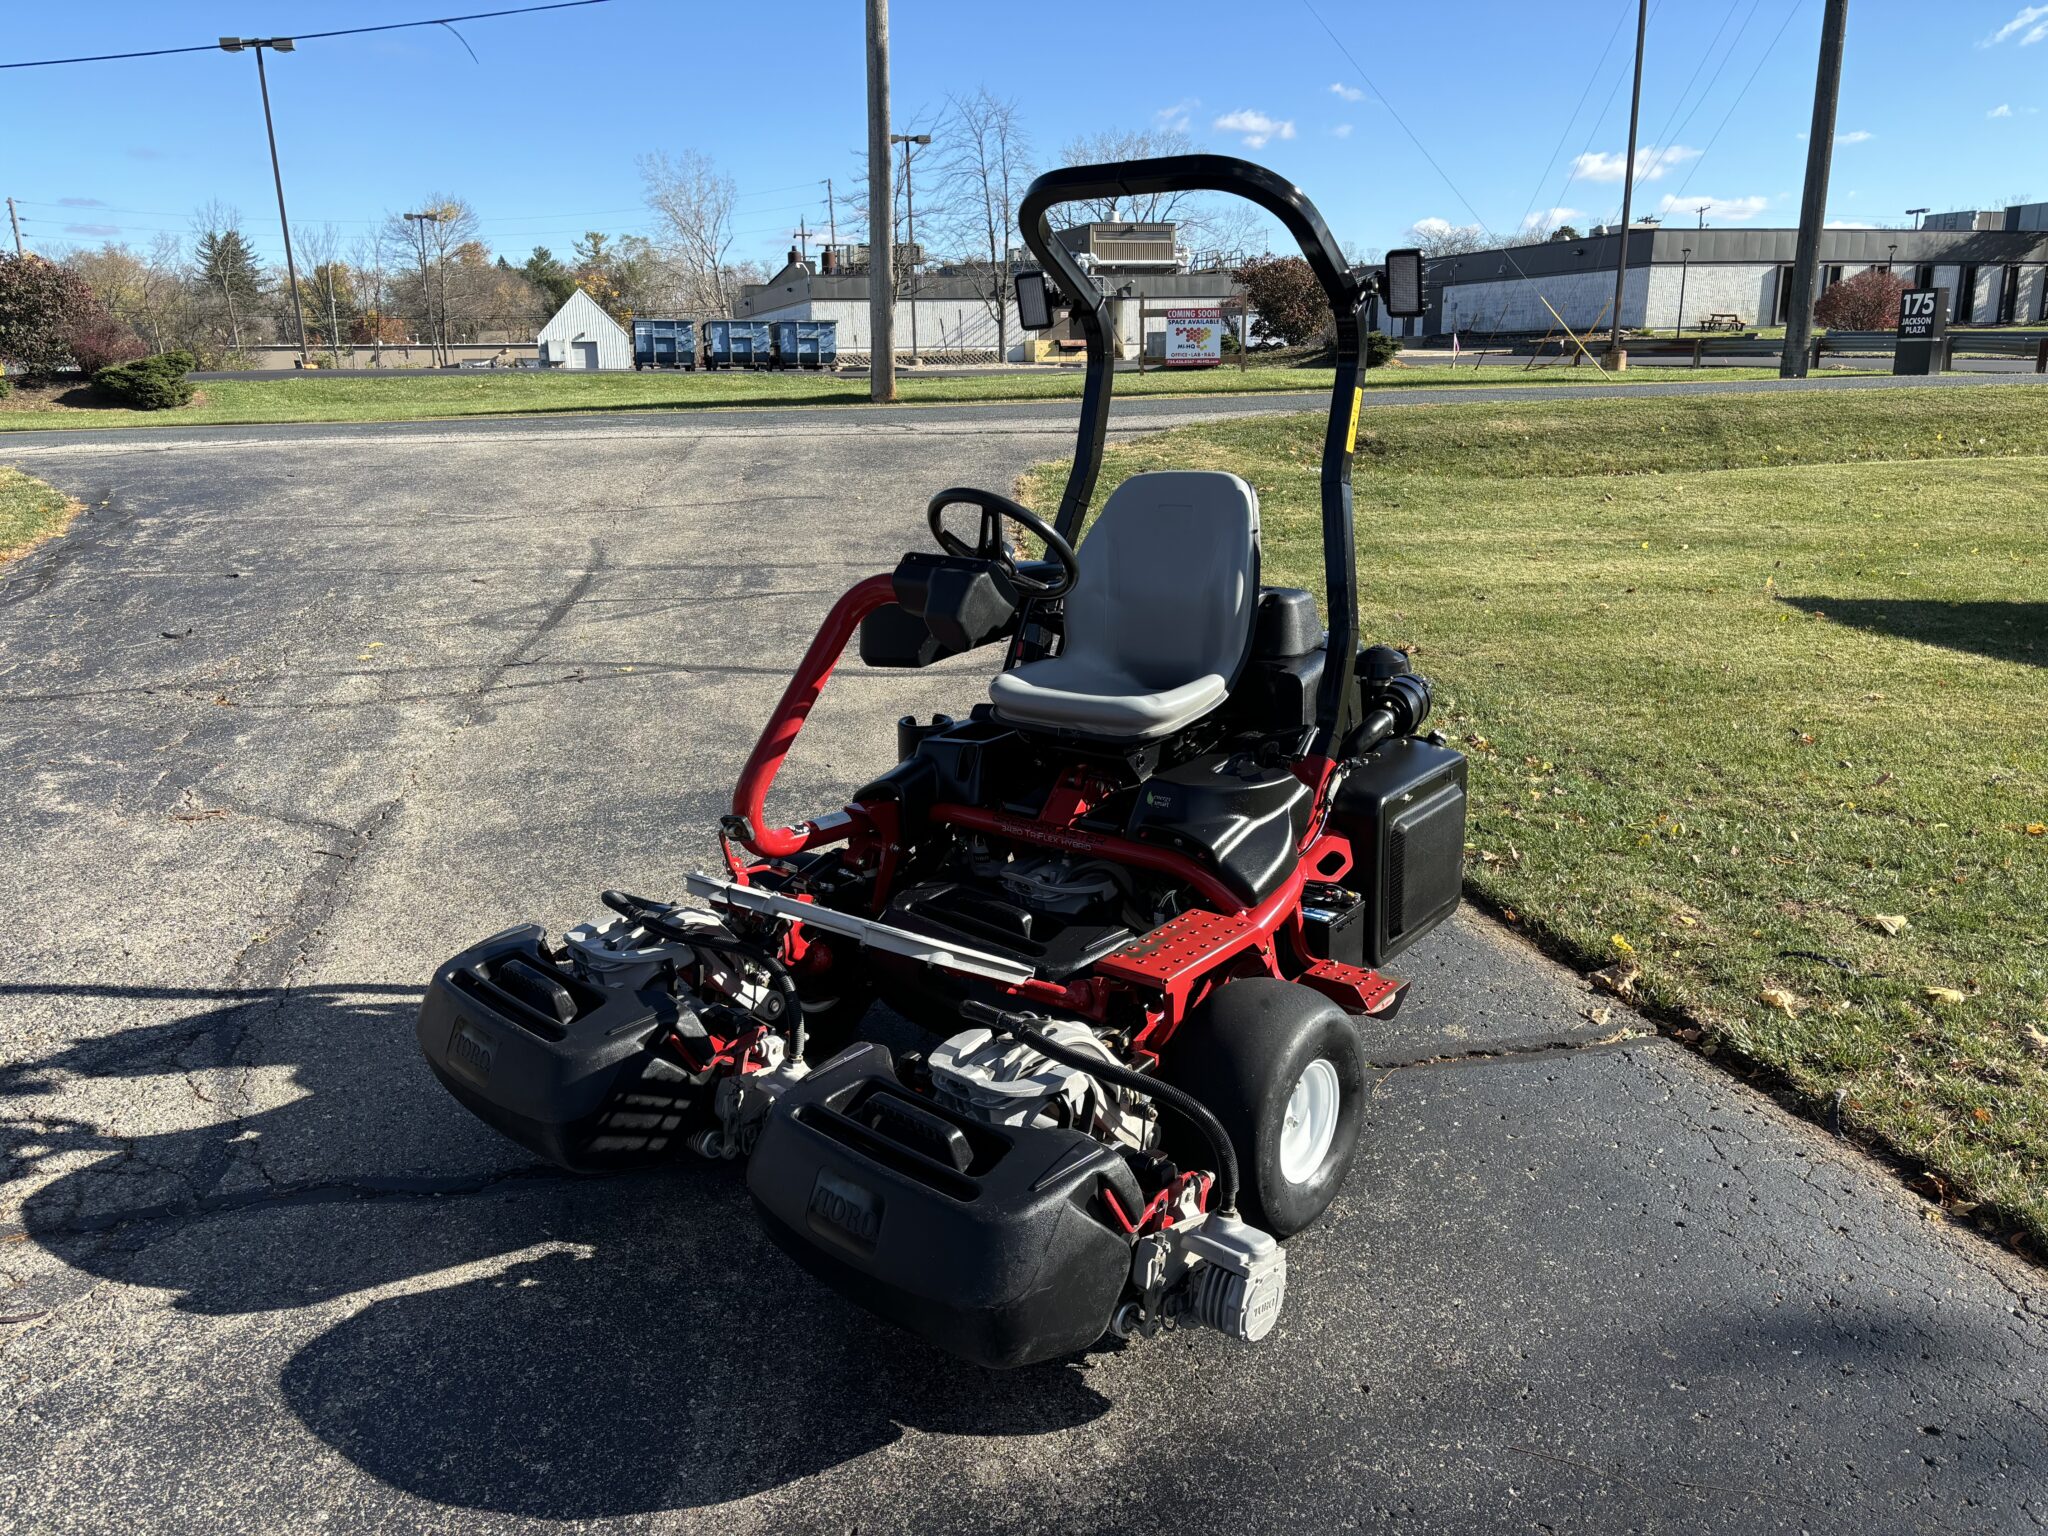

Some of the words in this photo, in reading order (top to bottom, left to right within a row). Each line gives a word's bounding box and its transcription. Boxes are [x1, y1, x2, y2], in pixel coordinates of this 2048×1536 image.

[1903, 292, 1935, 316] 175
[1167, 309, 1196, 318] COMING
[1197, 309, 1220, 318] SOON!
[1901, 316, 1932, 326] JACKSON
[1905, 325, 1926, 334] PLAZA
[454, 1032, 491, 1071] TORO
[816, 1185, 876, 1238] TORO
